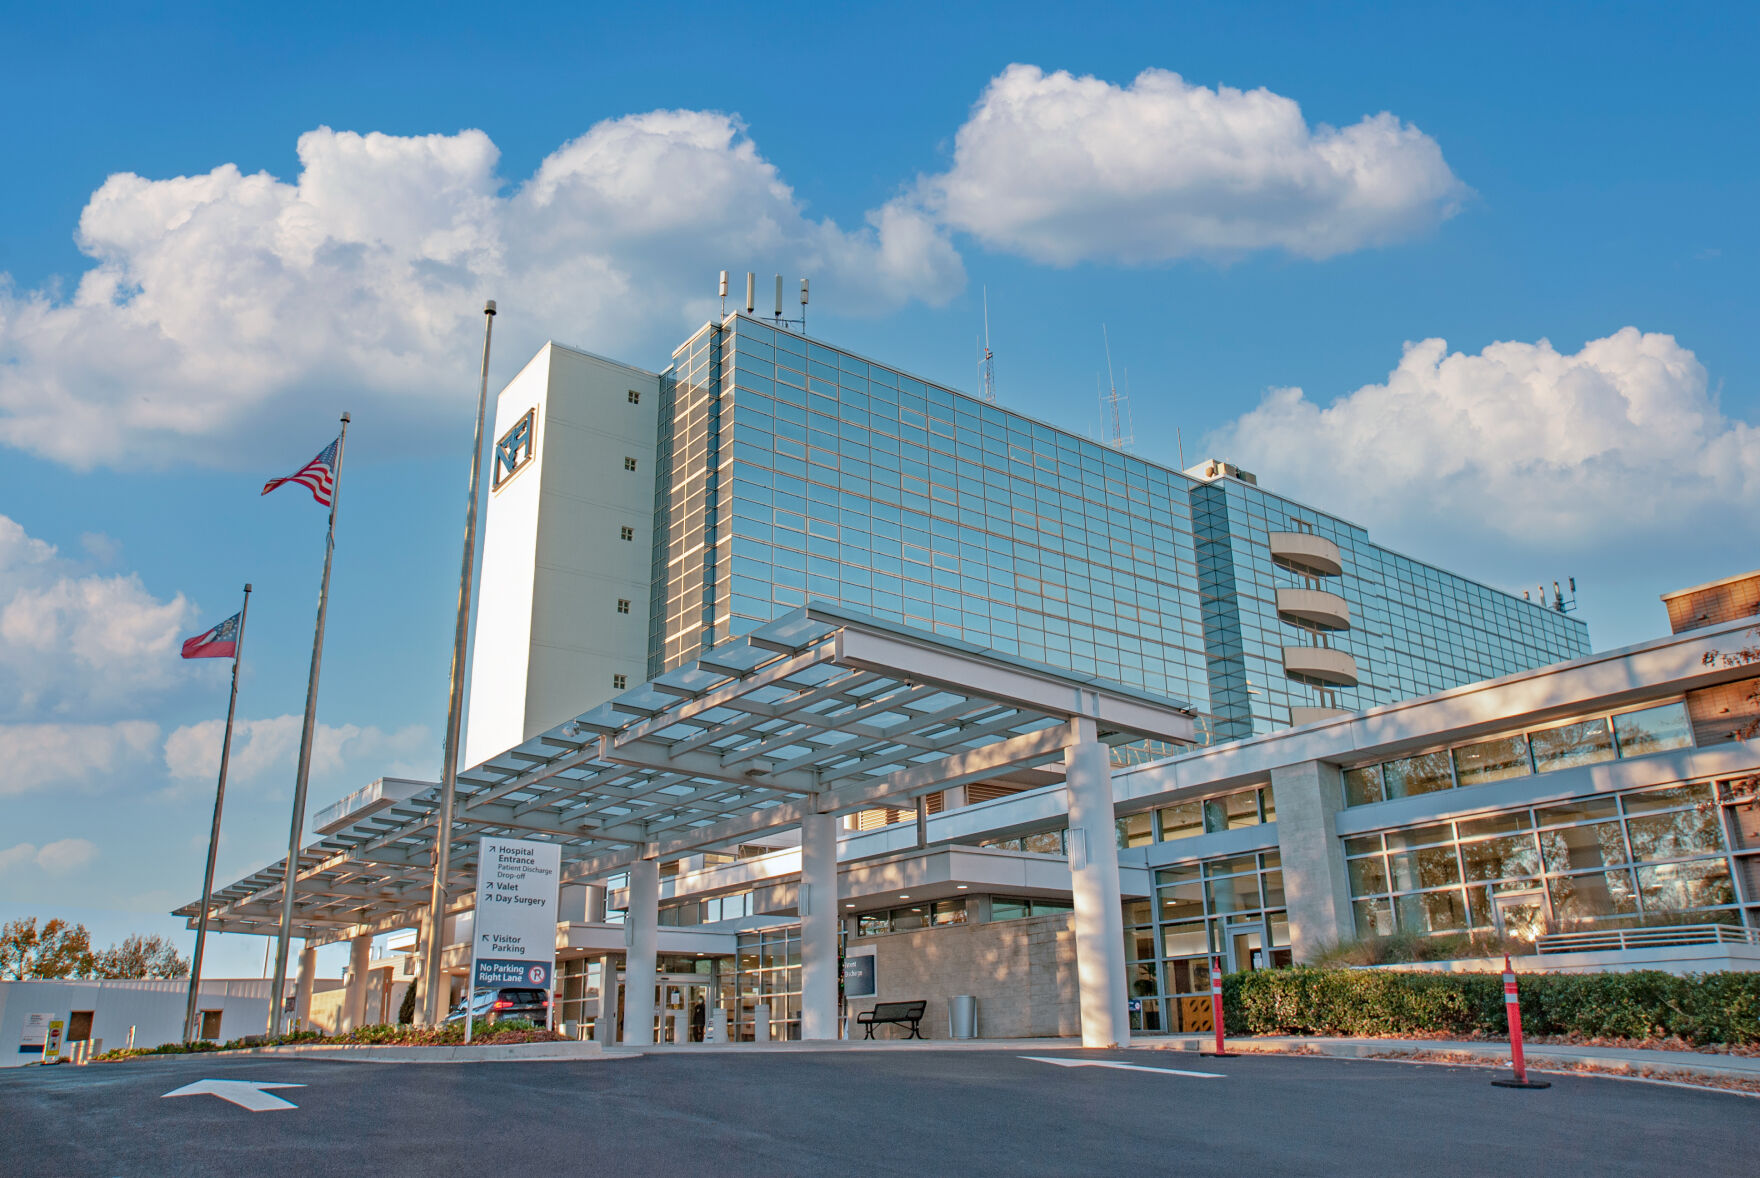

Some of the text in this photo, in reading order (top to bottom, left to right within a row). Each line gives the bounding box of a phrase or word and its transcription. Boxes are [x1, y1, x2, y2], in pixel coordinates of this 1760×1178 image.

[499, 846, 534, 856] Hospital
[498, 854, 535, 865] Entrance
[498, 863, 553, 875] Patient Discharge
[497, 871, 526, 880] Drop-off
[496, 882, 518, 891] Valet
[495, 893, 546, 907] Day Surgery
[492, 933, 521, 943] Visitor
[492, 943, 526, 955] Parking
[480, 963, 525, 975] No Parking
[479, 972, 523, 983] Right Lane
